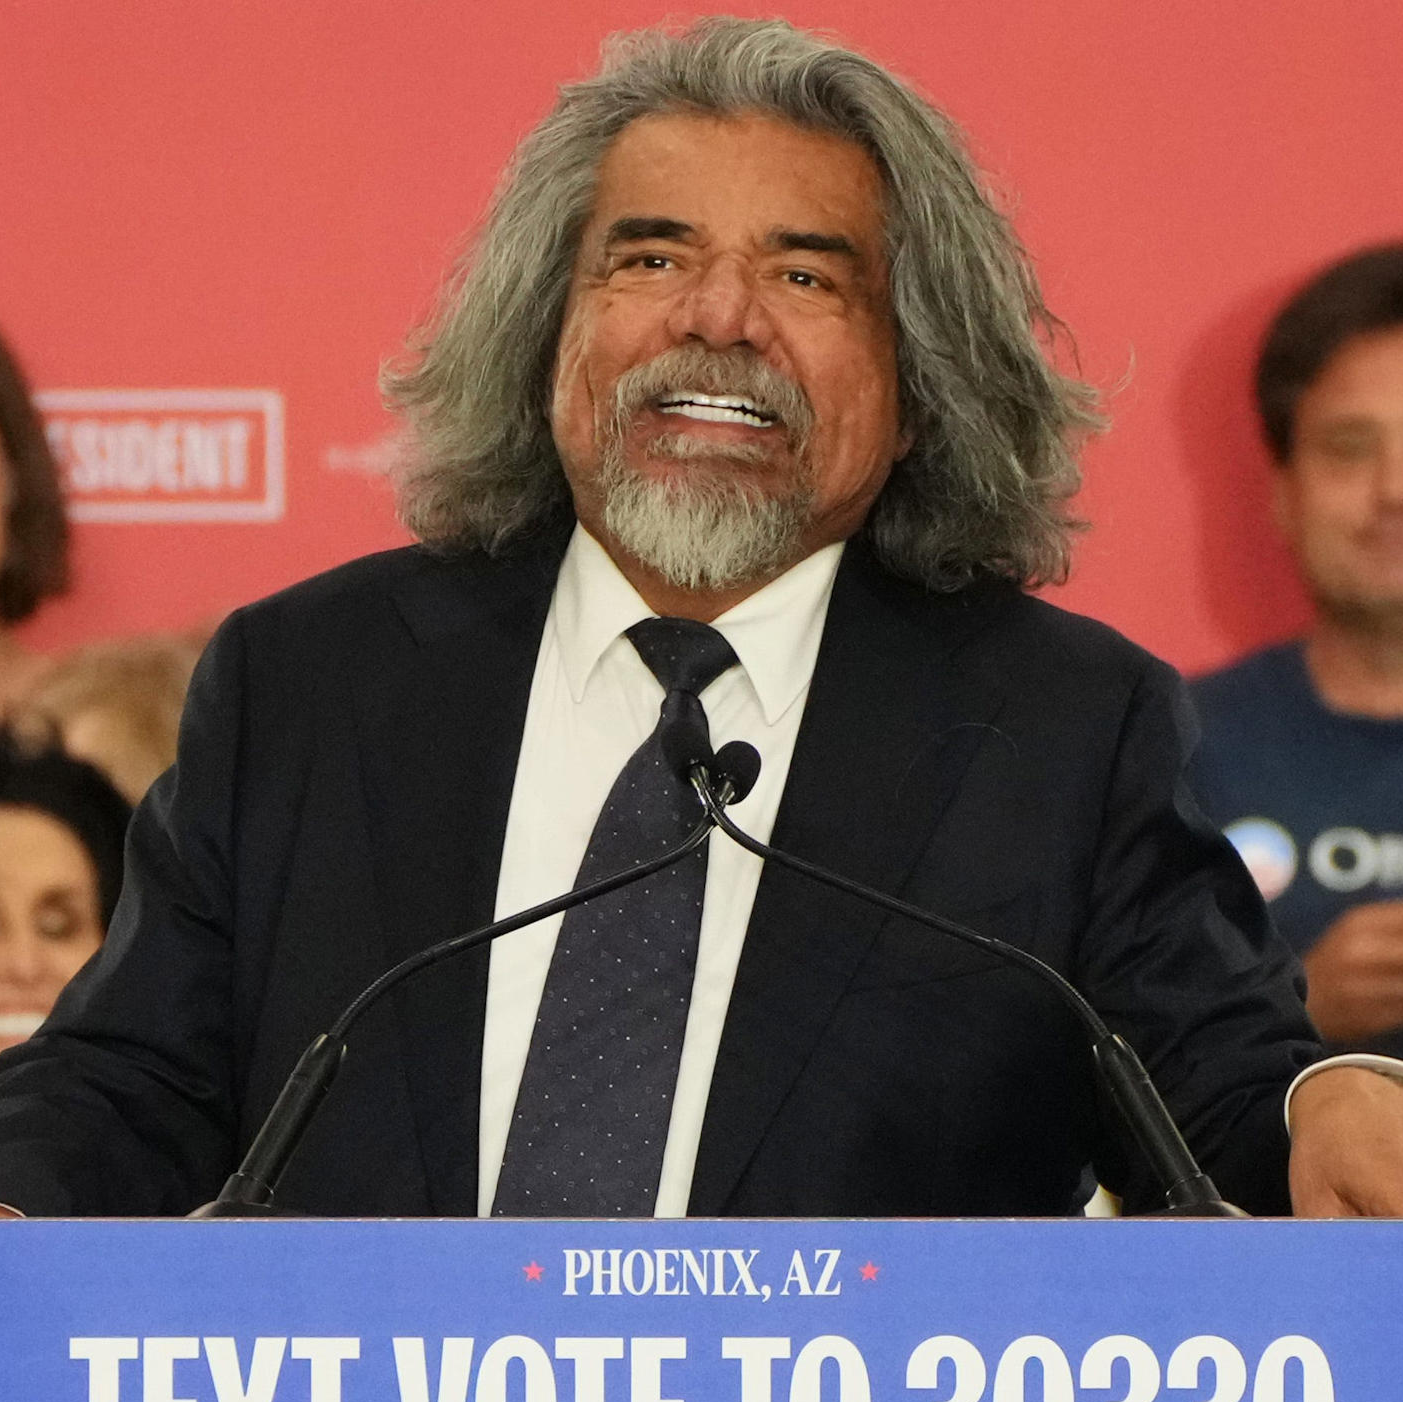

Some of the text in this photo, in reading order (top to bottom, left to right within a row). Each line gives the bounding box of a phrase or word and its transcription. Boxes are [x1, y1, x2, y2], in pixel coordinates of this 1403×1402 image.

[47, 419, 254, 494] SIDENT
[562, 1249, 842, 1303] PHOENIX, AZ
